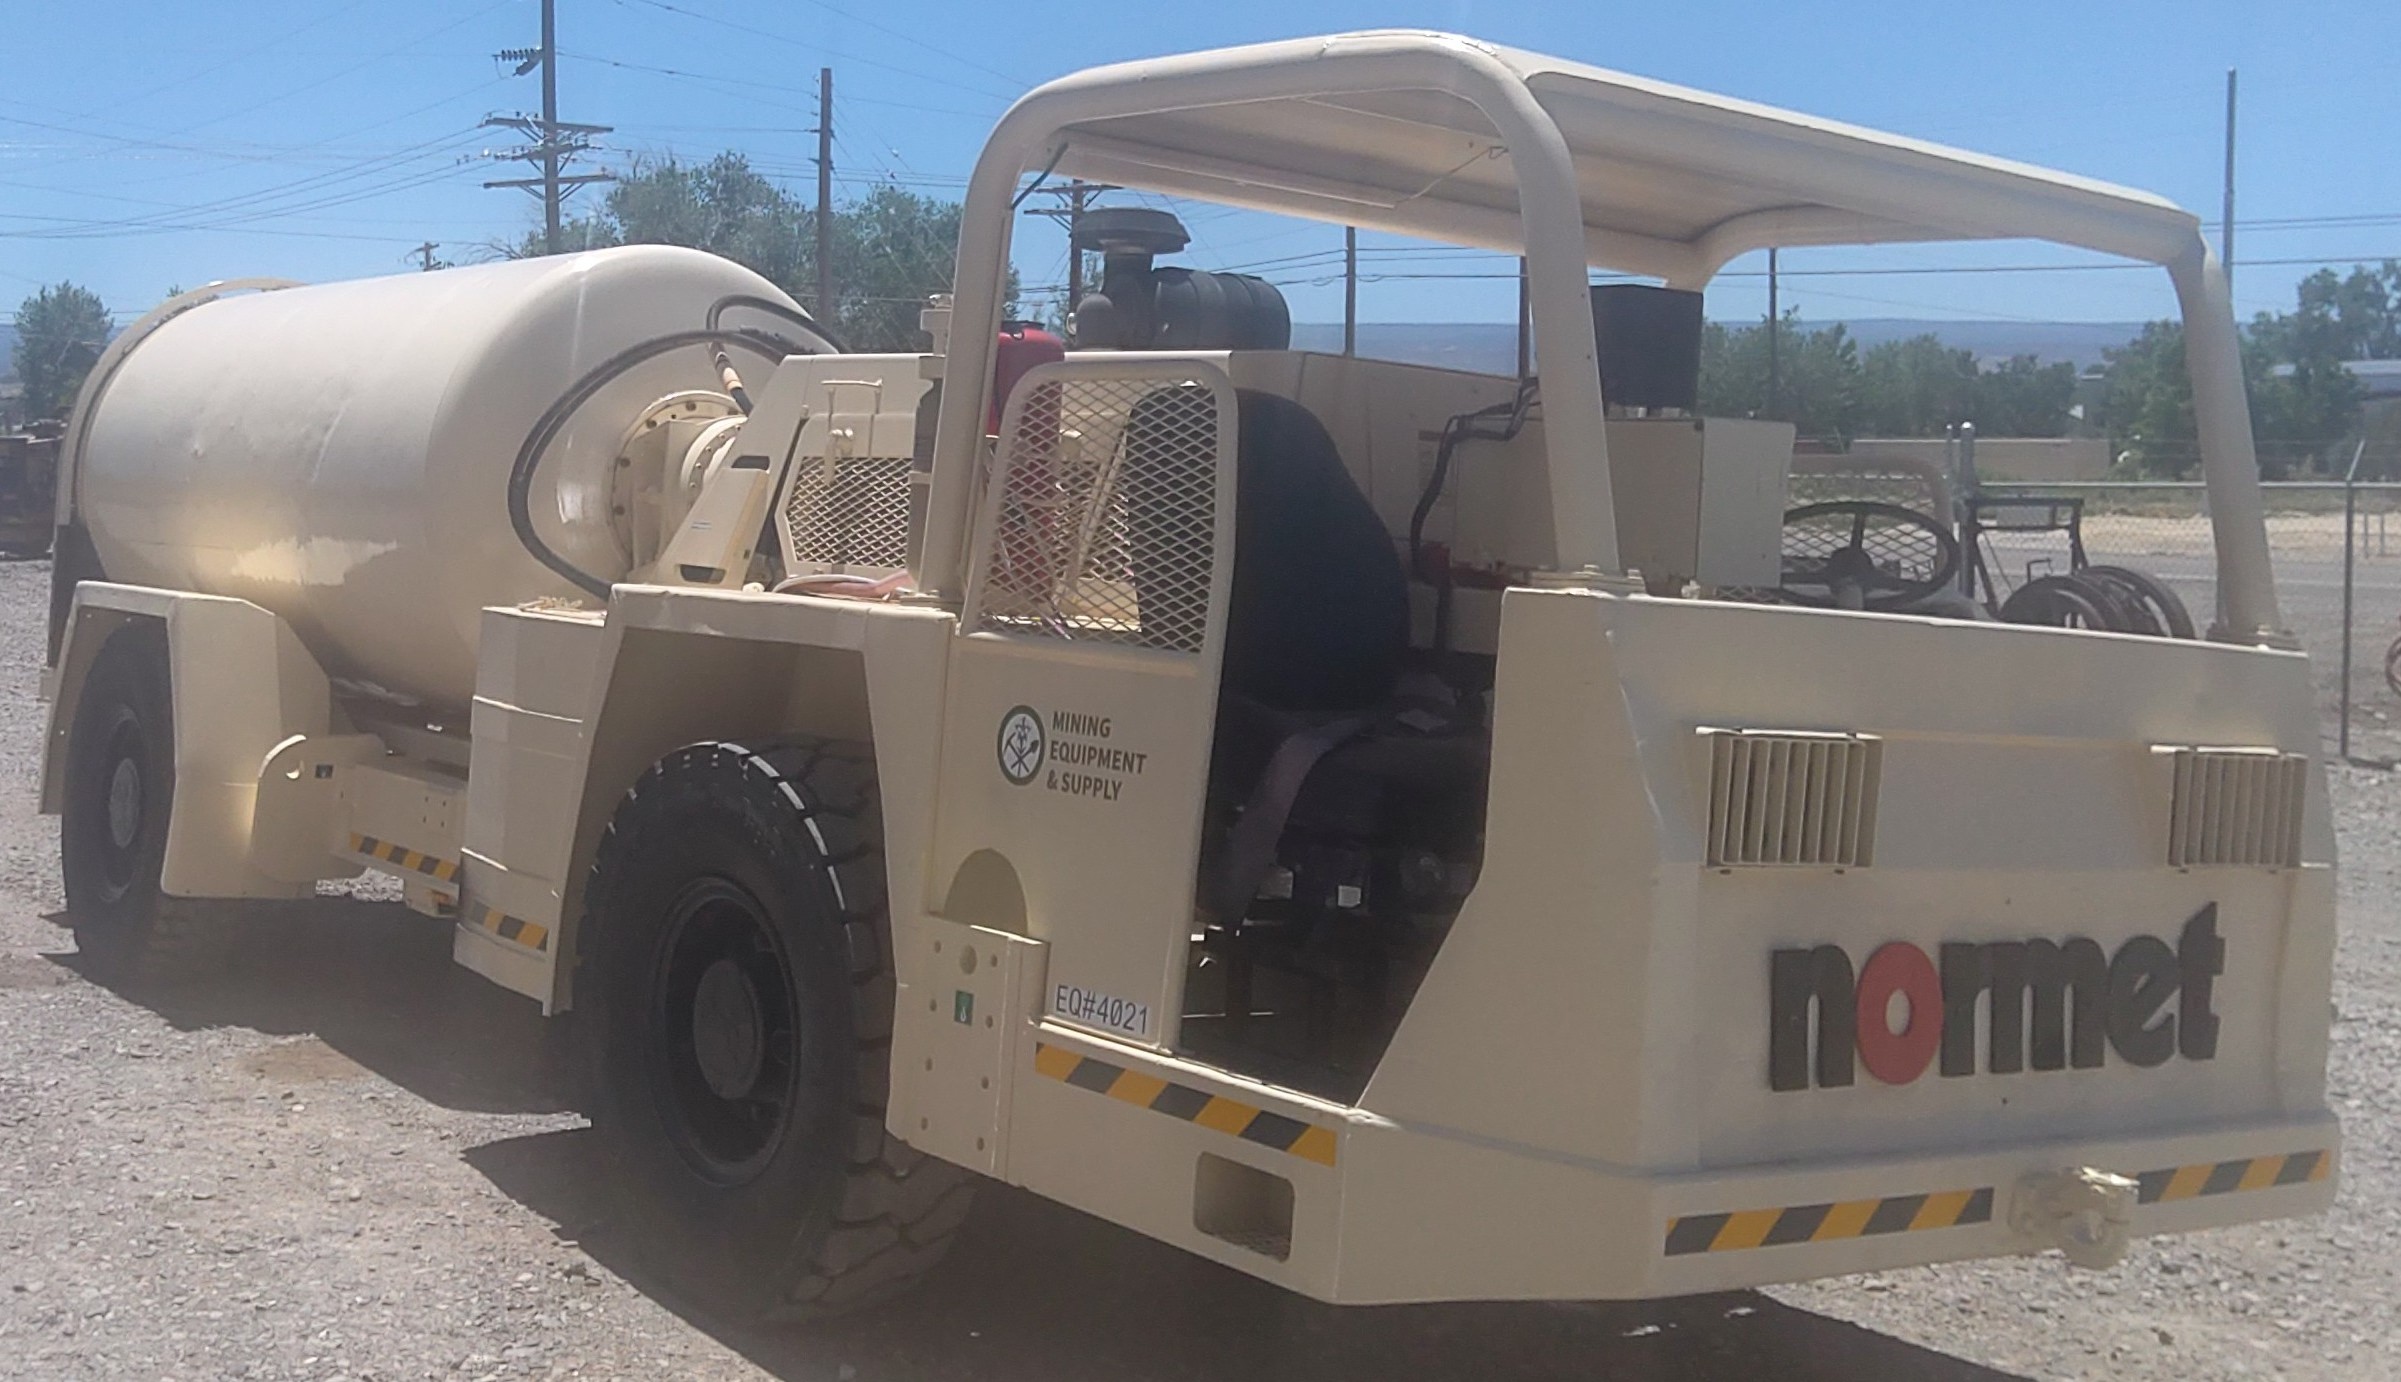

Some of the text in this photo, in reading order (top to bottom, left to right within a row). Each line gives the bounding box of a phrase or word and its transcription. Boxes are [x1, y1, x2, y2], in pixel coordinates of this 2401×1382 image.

[1053, 711, 1111, 738] MINING
[1049, 741, 1147, 774] EQUIPMENT
[1046, 770, 1122, 801] & SUPPLY
[1055, 984, 1148, 1034] EQ#4021
[1770, 901, 2226, 1092] normet
